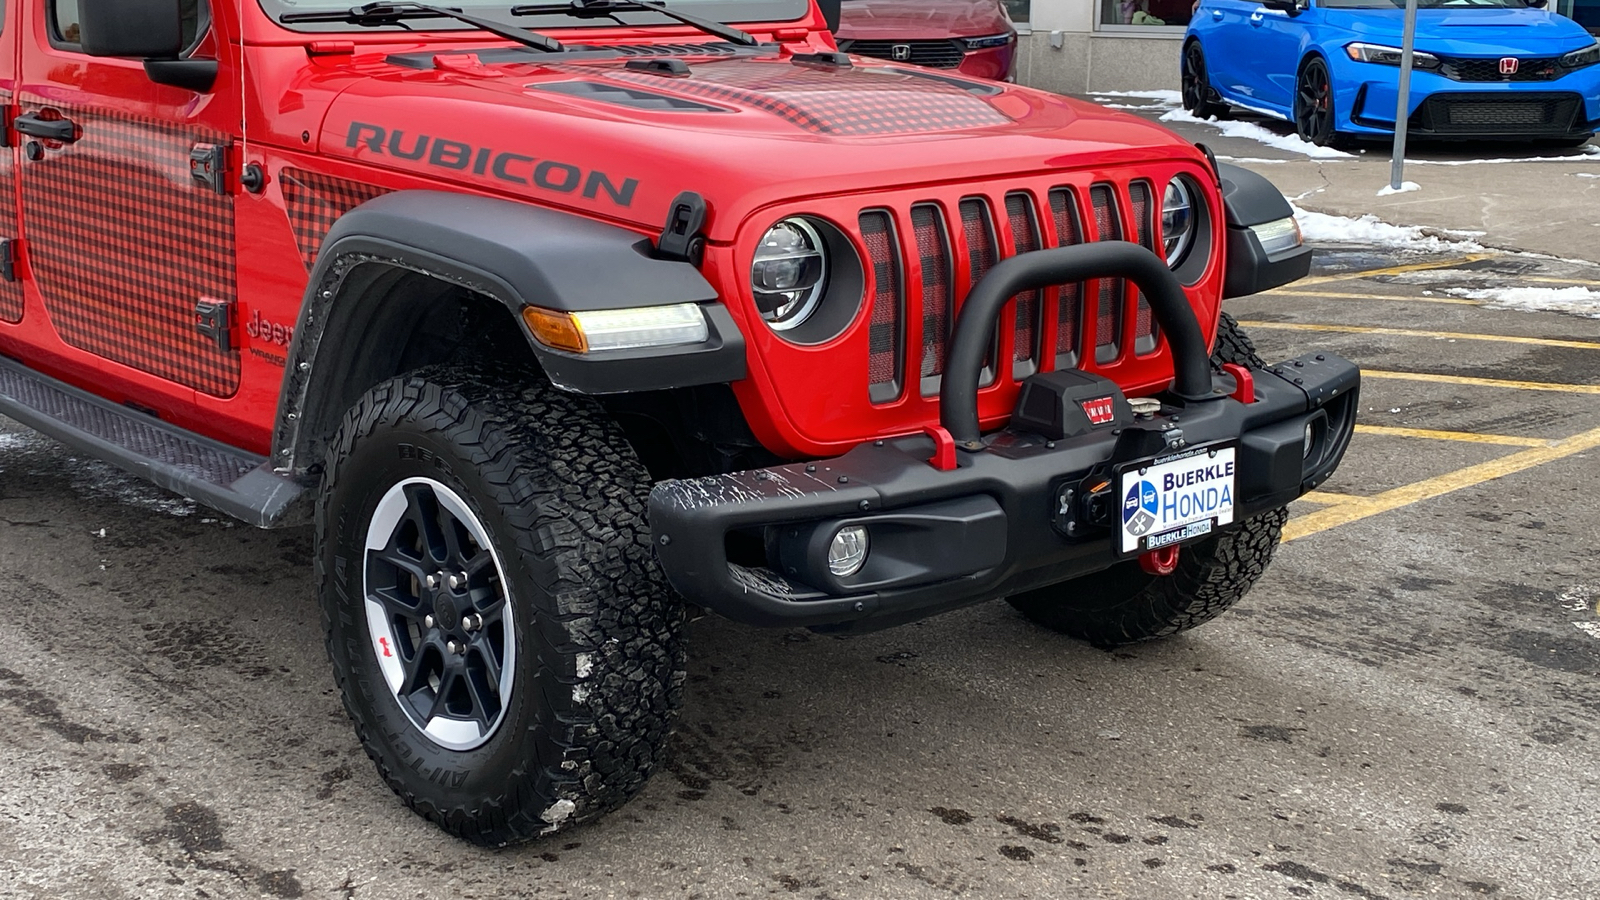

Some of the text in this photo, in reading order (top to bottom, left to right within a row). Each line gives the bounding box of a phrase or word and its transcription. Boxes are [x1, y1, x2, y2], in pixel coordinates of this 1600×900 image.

[346, 121, 639, 207] RUBICON
[1163, 461, 1234, 492] BUERKLE
[1162, 484, 1232, 523] HONDA
